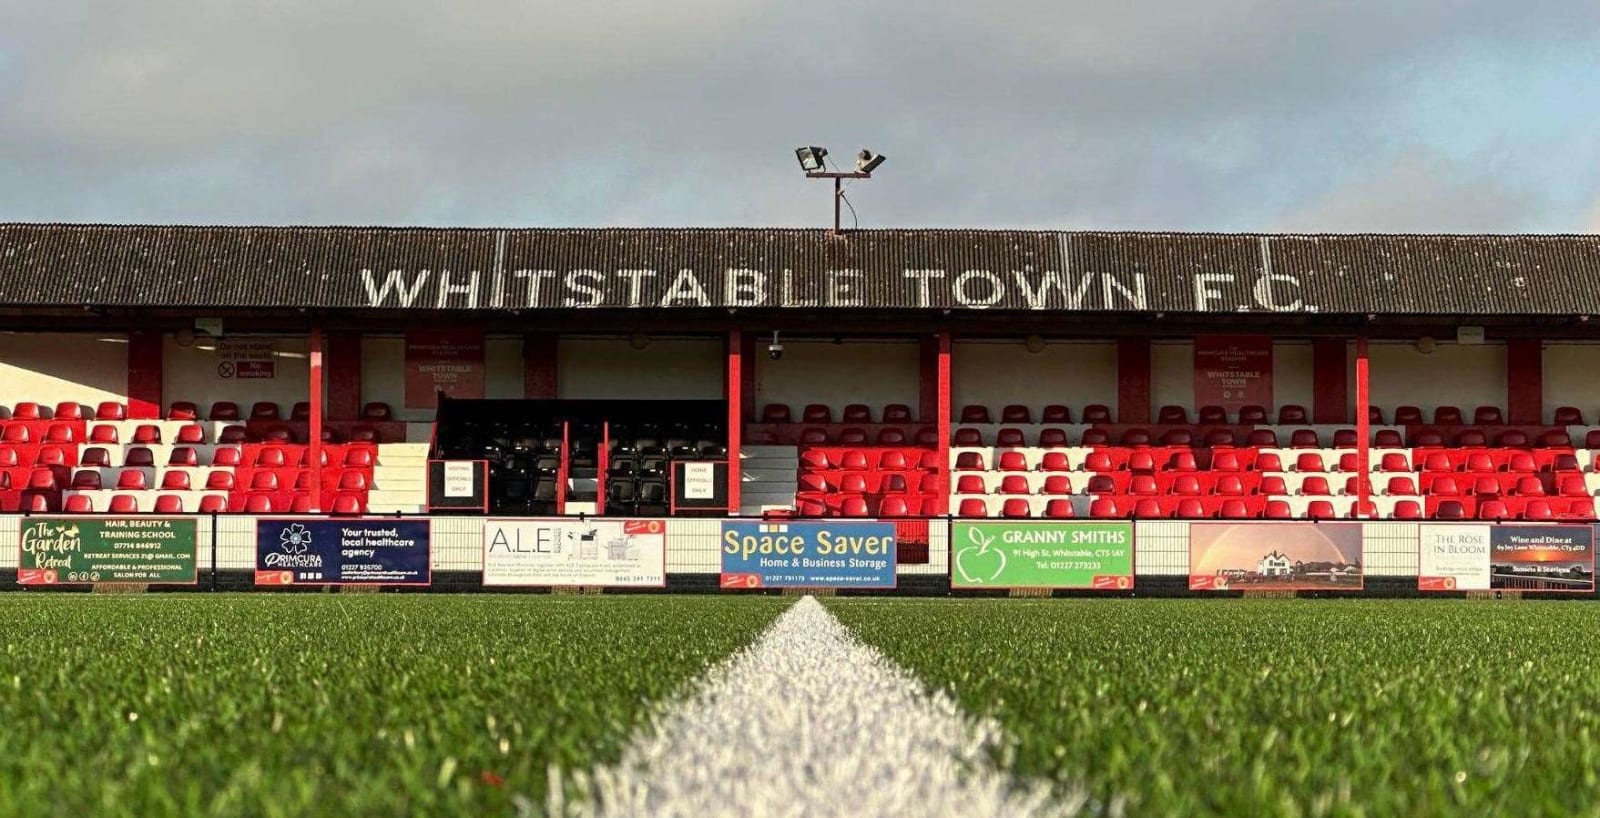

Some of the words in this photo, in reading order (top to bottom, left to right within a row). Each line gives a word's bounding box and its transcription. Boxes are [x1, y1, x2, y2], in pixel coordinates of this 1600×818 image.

[361, 268, 864, 309] WHITSTABLE
[904, 268, 1148, 310] TOWN
[105, 520, 128, 529] HAIR,
[129, 520, 162, 528] BEAUTY
[164, 520, 171, 528] &
[36, 523, 54, 538] The
[99, 531, 140, 539] TRAINING
[141, 531, 176, 539] SCHOOL
[341, 528, 364, 537] Your
[364, 528, 398, 538] trusted,
[22, 528, 80, 554] Garden
[341, 538, 364, 546] local
[365, 538, 414, 547] healthcare
[489, 528, 551, 553] A.L.E
[1002, 531, 1066, 544] GRANNY
[1071, 531, 1125, 544] SMITHS
[1436, 534, 1454, 544] THE
[1458, 534, 1484, 544] ROSE
[1546, 536, 1563, 544] Dine
[724, 530, 805, 560] Space
[816, 531, 893, 554] Saver
[1434, 545, 1446, 554] IN
[1448, 545, 1485, 554] BLOOM
[341, 549, 375, 558] agency
[1022, 549, 1040, 559] High
[35, 552, 72, 569] Retreat
[264, 552, 322, 567] PRIMCURA
[760, 558, 789, 568] Home
[791, 558, 800, 568] &
[802, 558, 845, 568] Business
[849, 558, 887, 570] Storage
